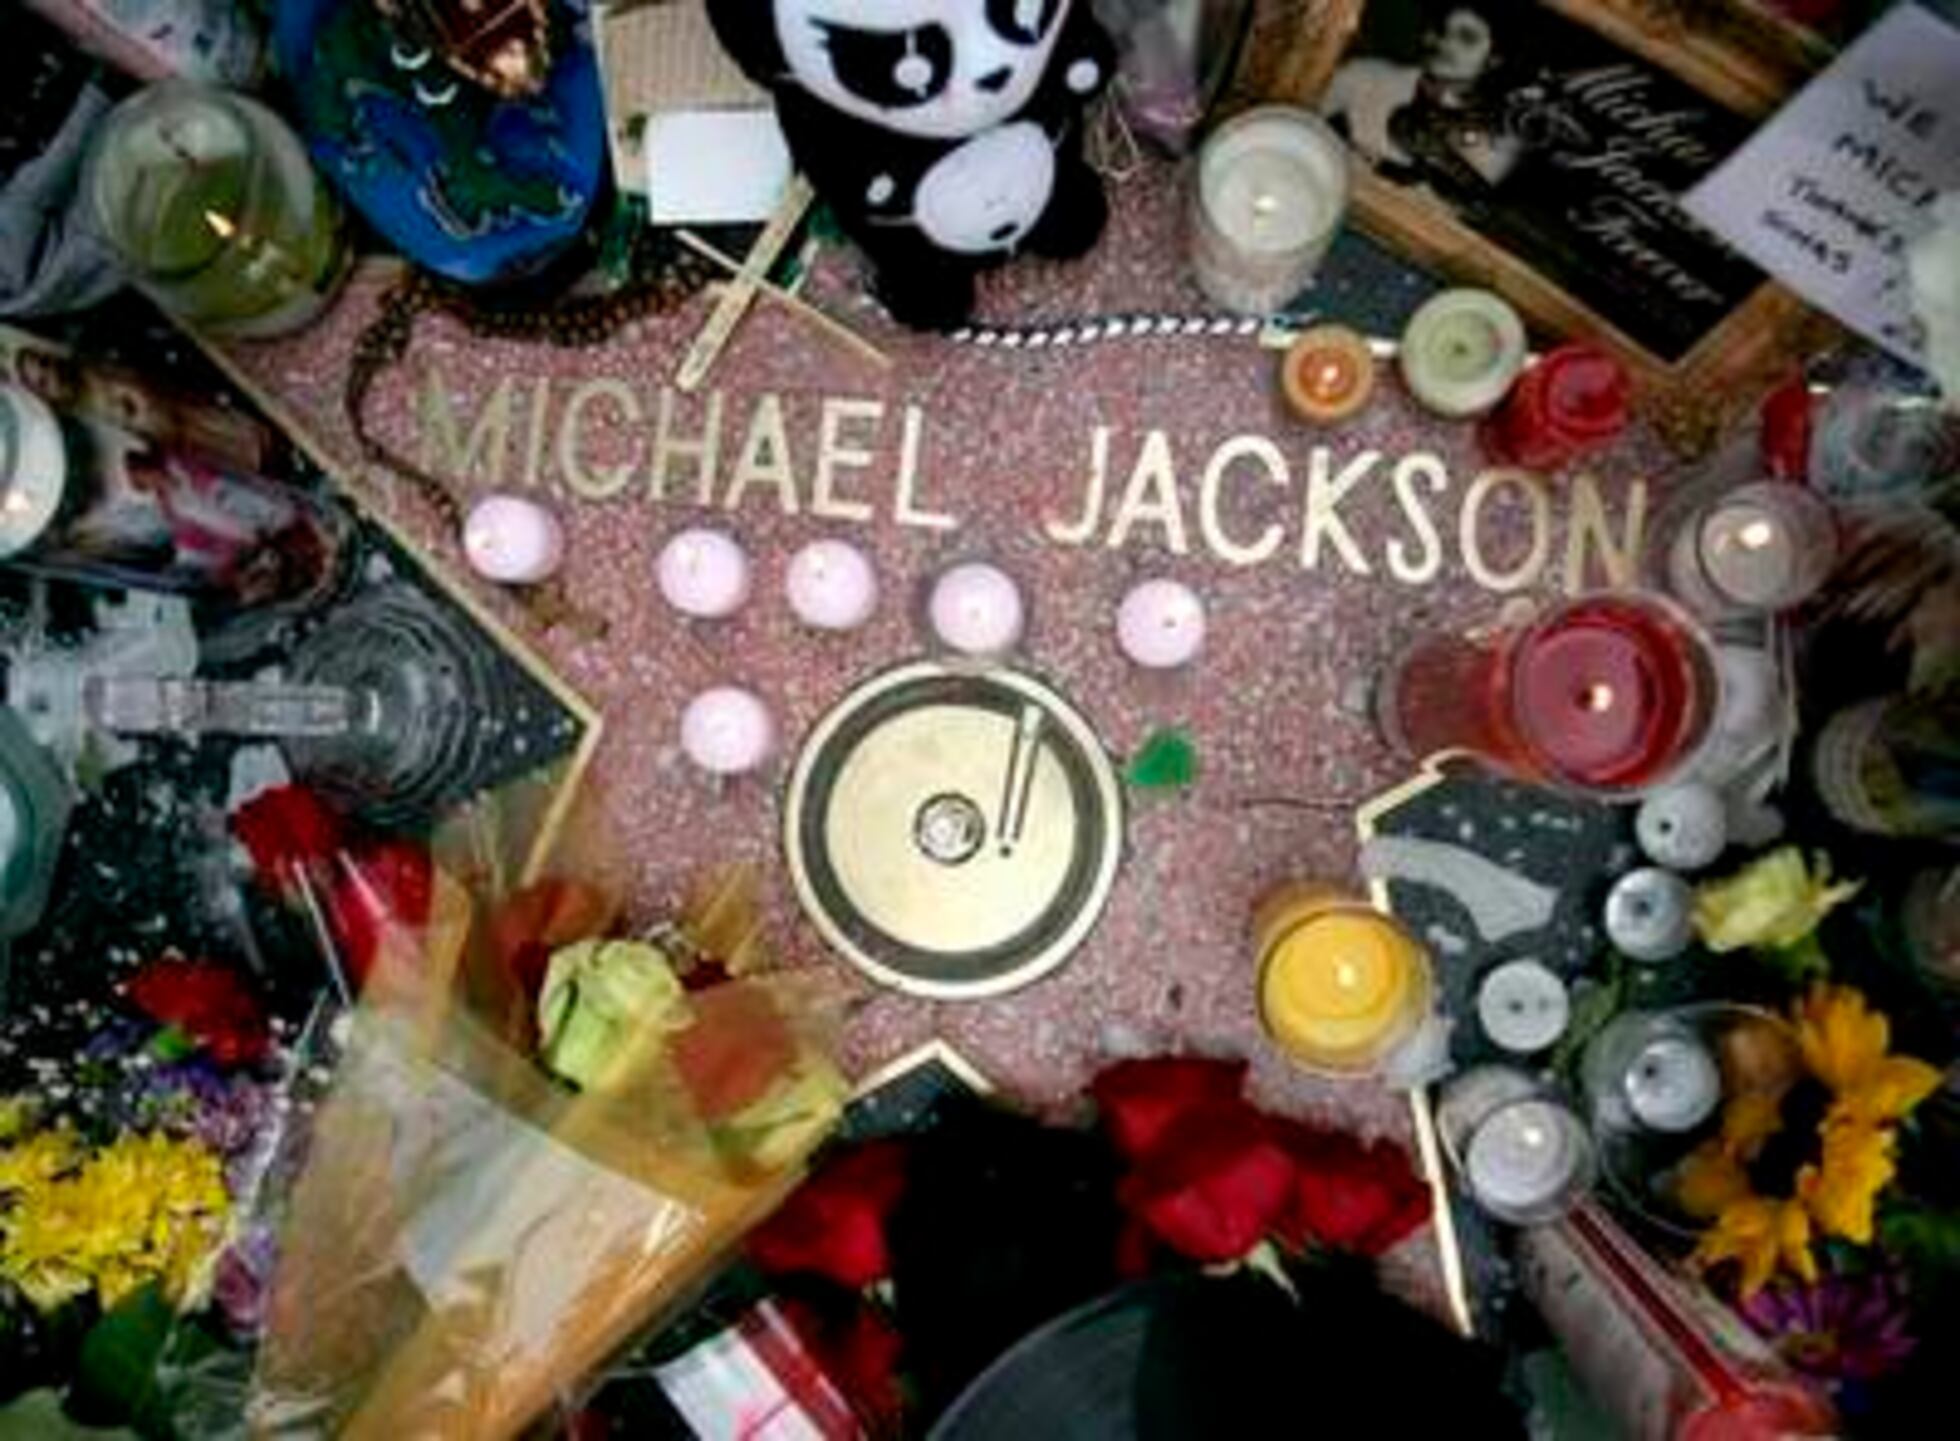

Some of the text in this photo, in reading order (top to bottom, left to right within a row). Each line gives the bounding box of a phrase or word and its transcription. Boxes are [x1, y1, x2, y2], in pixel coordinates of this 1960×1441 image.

[1861, 78, 1938, 139] WE
[410, 370, 1648, 596] MICHAEL JACKSON
